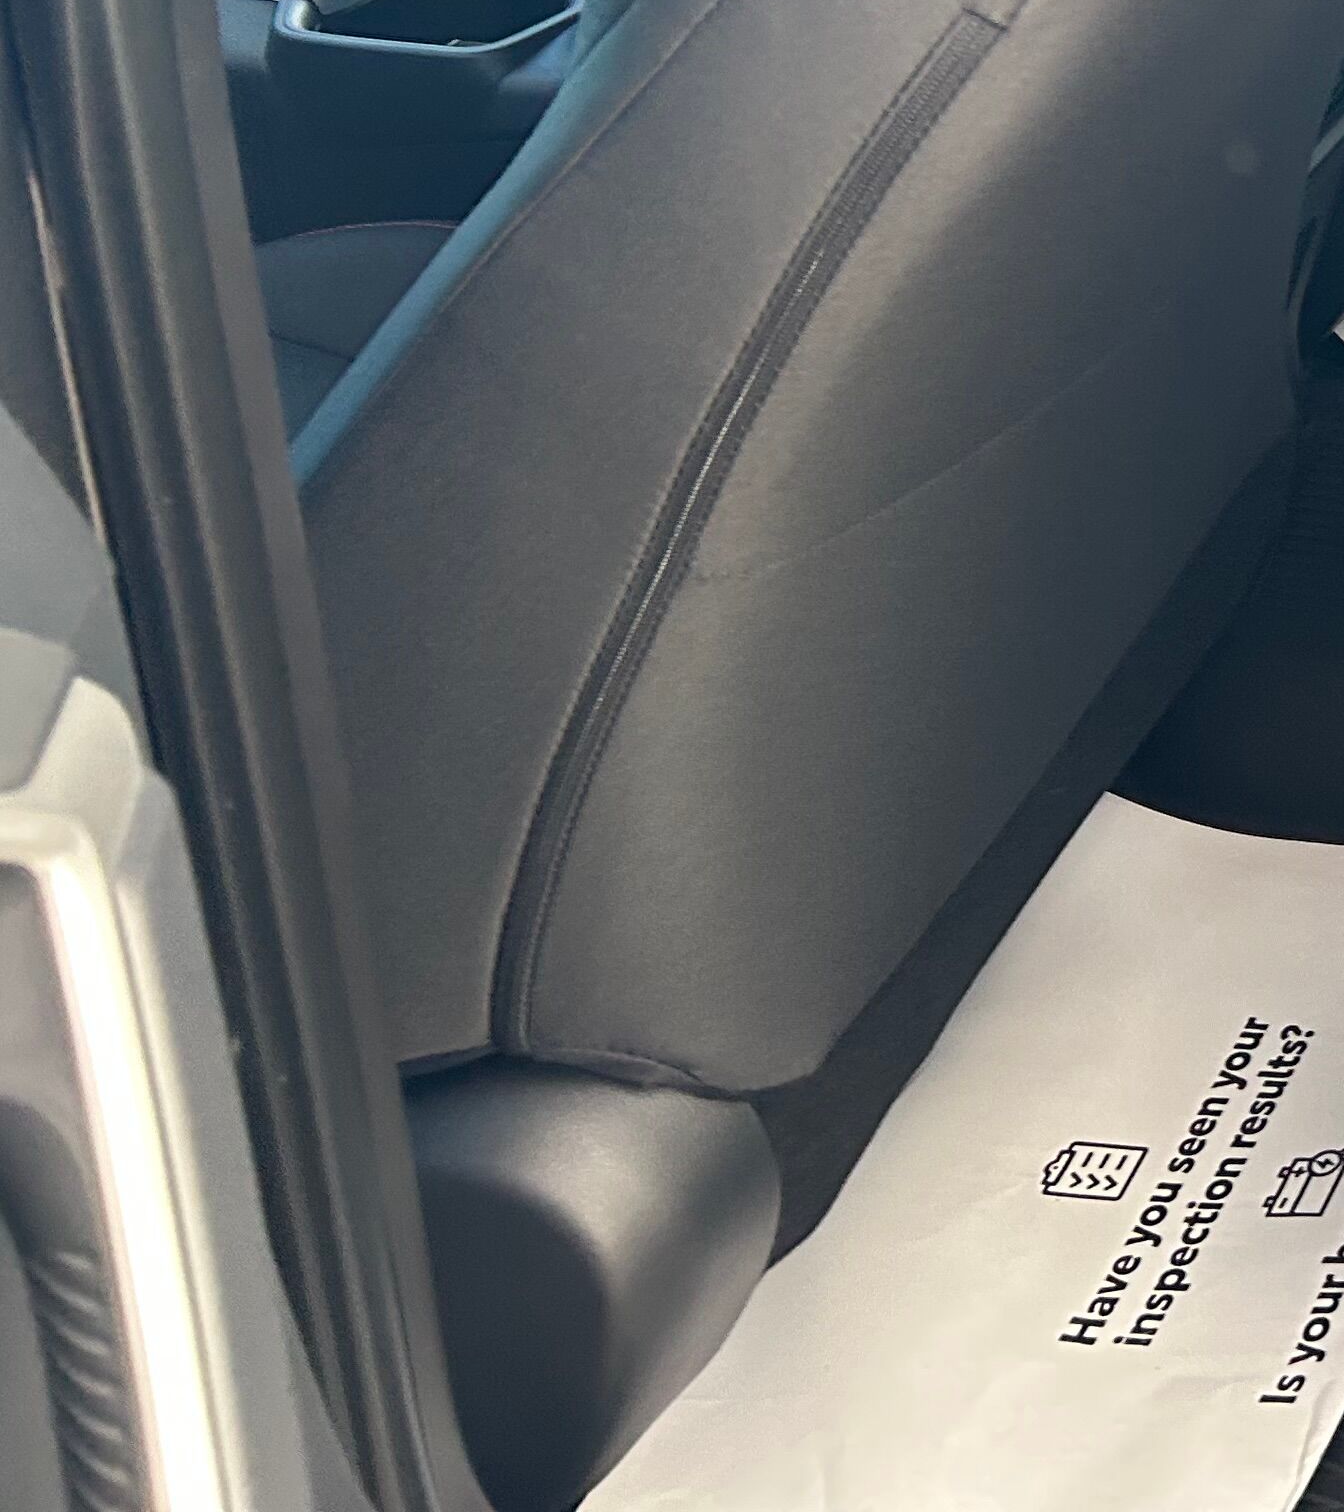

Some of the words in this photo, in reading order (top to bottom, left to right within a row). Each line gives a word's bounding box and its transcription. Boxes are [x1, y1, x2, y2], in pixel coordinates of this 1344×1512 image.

[1058, 1254, 1142, 1346] Have
[1125, 1181, 1183, 1248] you
[1168, 1095, 1230, 1174] seen
[1211, 1016, 1270, 1090] your
[1113, 1157, 1248, 1347] inspection
[1230, 1024, 1316, 1149] results?
[1258, 1373, 1306, 1405] Is
